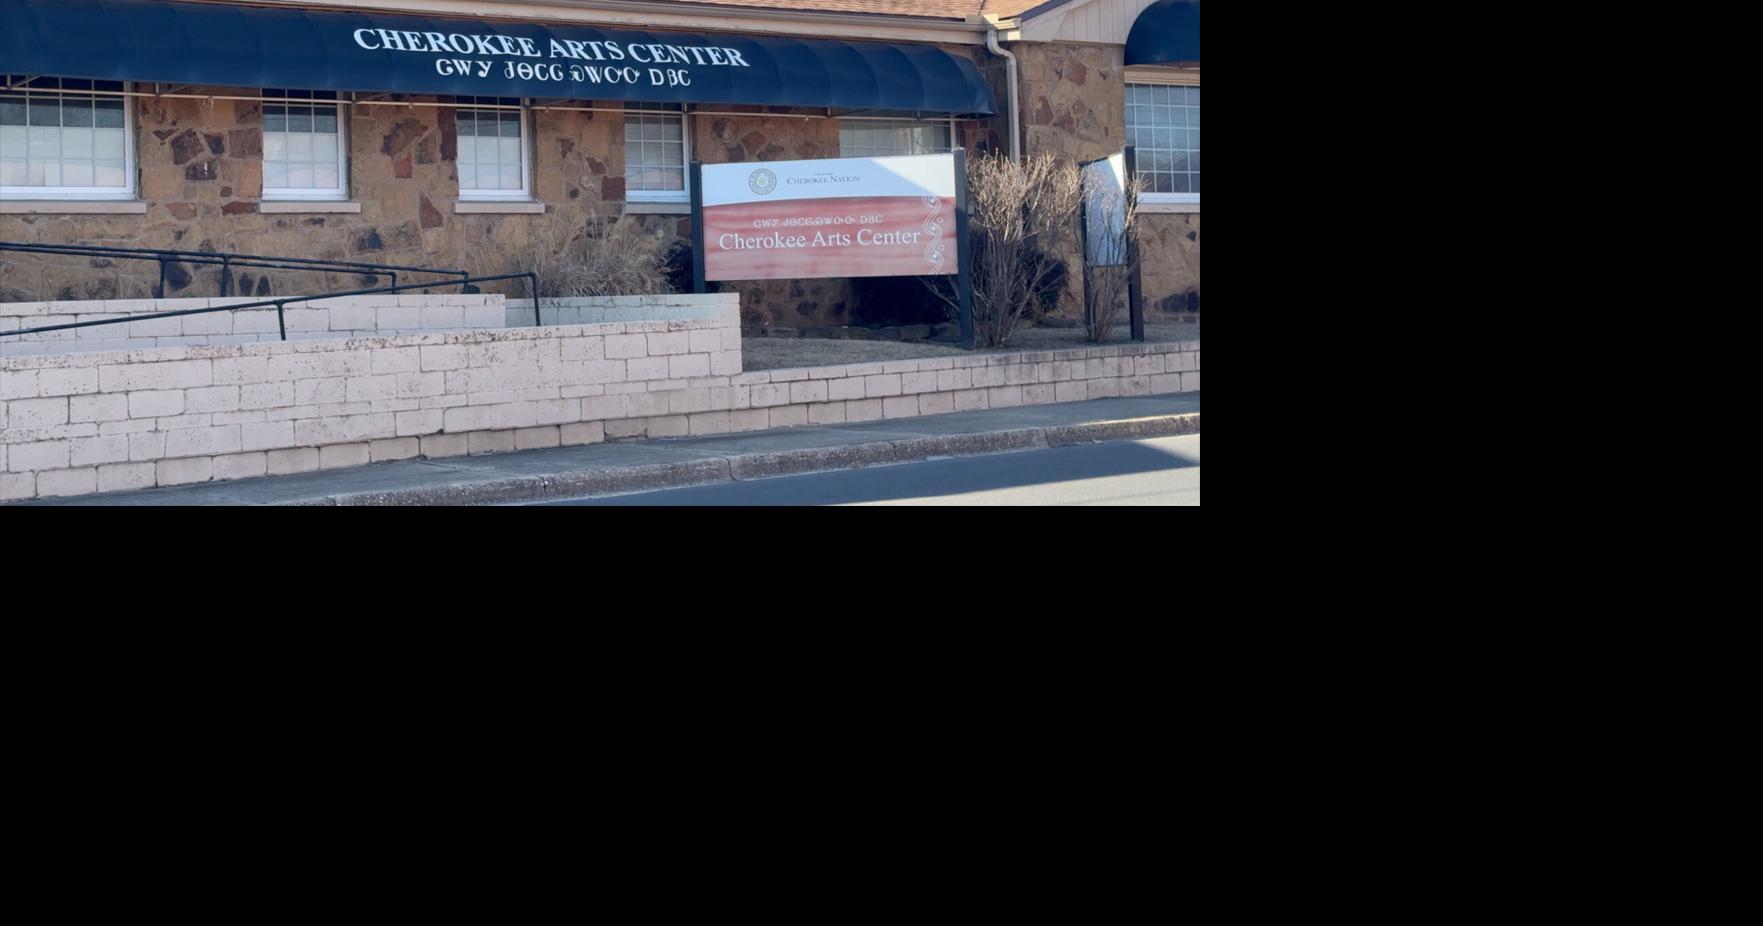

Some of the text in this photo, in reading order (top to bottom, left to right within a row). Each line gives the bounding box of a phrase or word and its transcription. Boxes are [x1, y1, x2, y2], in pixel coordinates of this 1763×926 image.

[353, 28, 751, 68] CHEROKEE ARTS CENTER
[719, 228, 921, 250] Cherokee Arts Center
